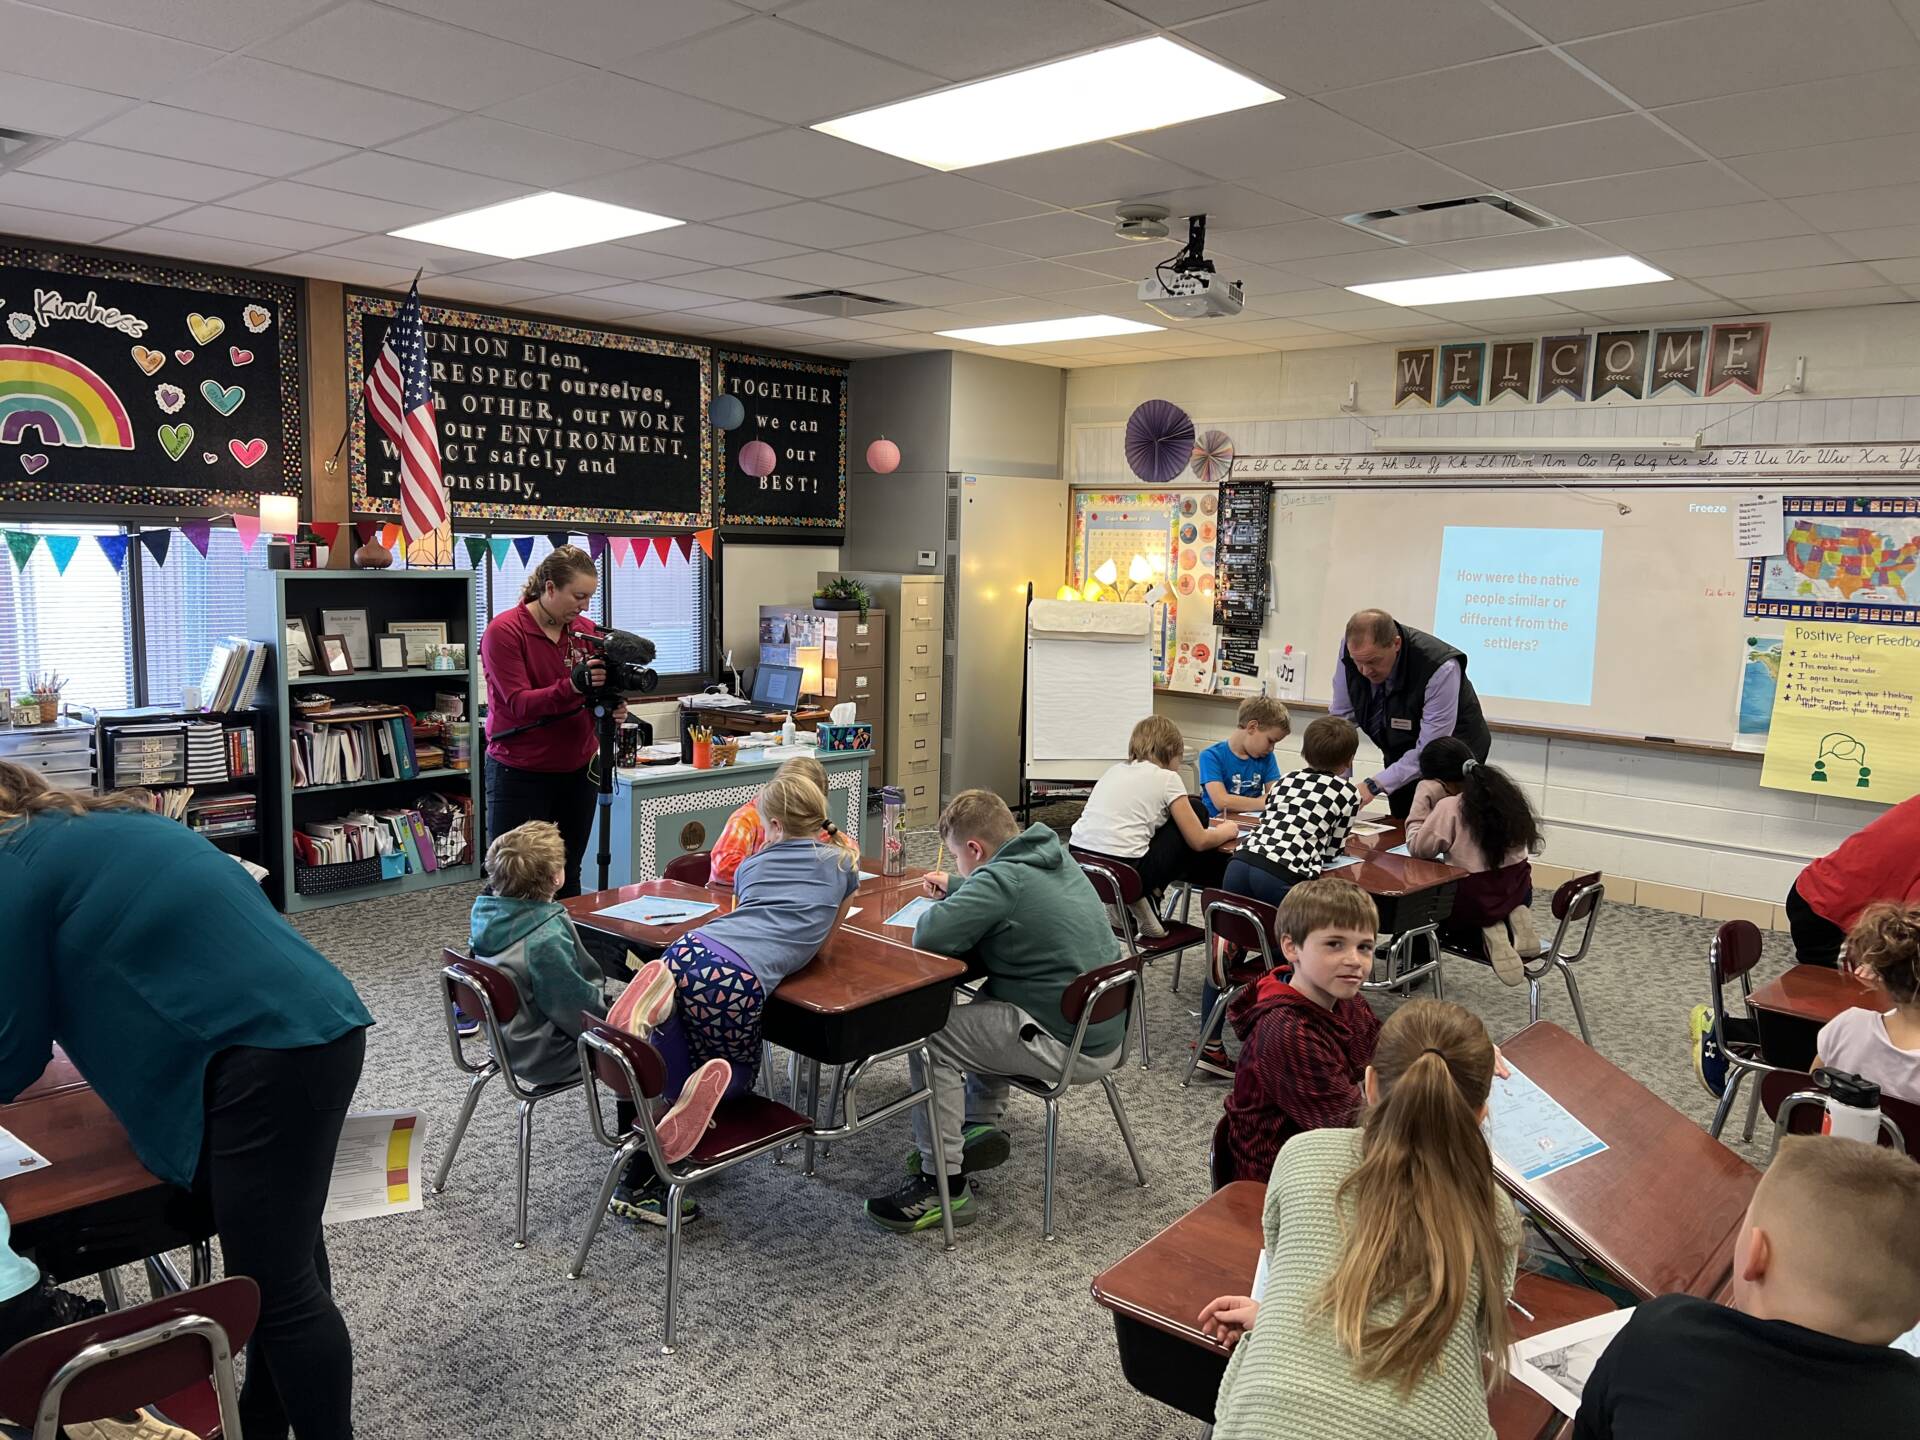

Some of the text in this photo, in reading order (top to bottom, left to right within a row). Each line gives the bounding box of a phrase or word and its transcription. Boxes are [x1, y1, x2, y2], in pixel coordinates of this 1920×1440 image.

[36, 290, 147, 336] Kindness
[424, 331, 510, 358] UNION
[523, 345, 589, 373] Elem.
[1401, 331, 1752, 385] WELCOME
[432, 362, 671, 408] RESPECT ourselves,
[731, 378, 832, 404] TOGETHER
[462, 395, 563, 425] OTHER,
[573, 407, 610, 426] our
[620, 409, 686, 433] WORK
[757, 415, 818, 432] we can
[445, 422, 688, 459] our ENVIRONMENT.
[439, 444, 477, 464] CT
[490, 448, 566, 476] safely
[579, 455, 617, 475] and
[786, 448, 816, 462] our
[1234, 461, 1248, 471] Aa
[1254, 460, 1268, 471] Bb
[1274, 460, 1286, 471] Cc
[1292, 459, 1309, 471] Dd
[1315, 459, 1328, 470] Ee
[1335, 458, 1352, 474] Ff
[1357, 458, 1375, 474] Gg
[1382, 457, 1398, 469] Hh
[1448, 456, 1467, 469] Kk
[1475, 455, 1495, 468] Ll
[1502, 455, 1534, 467] Mm
[1542, 454, 1567, 467] Nn
[1578, 453, 1598, 467] Oo
[1608, 454, 1626, 471] Pp
[1634, 454, 1657, 471] Qq
[1667, 454, 1688, 466] Rr
[1698, 452, 1717, 466] Ss
[1727, 451, 1749, 465] Tt
[1755, 451, 1778, 464] Uu
[1786, 450, 1811, 464] Vv
[1818, 449, 1850, 464] Ww
[1859, 449, 1889, 463] Xx
[760, 475, 818, 493] BEST!
[1689, 503, 1727, 513] Freeze
[1457, 569, 1580, 587] How were the native
[1465, 593, 1567, 609] people similar or
[1460, 613, 1569, 631] different from the
[1484, 637, 1539, 651] settlers?
[1796, 627, 1920, 648] Positive Peer Feedba
